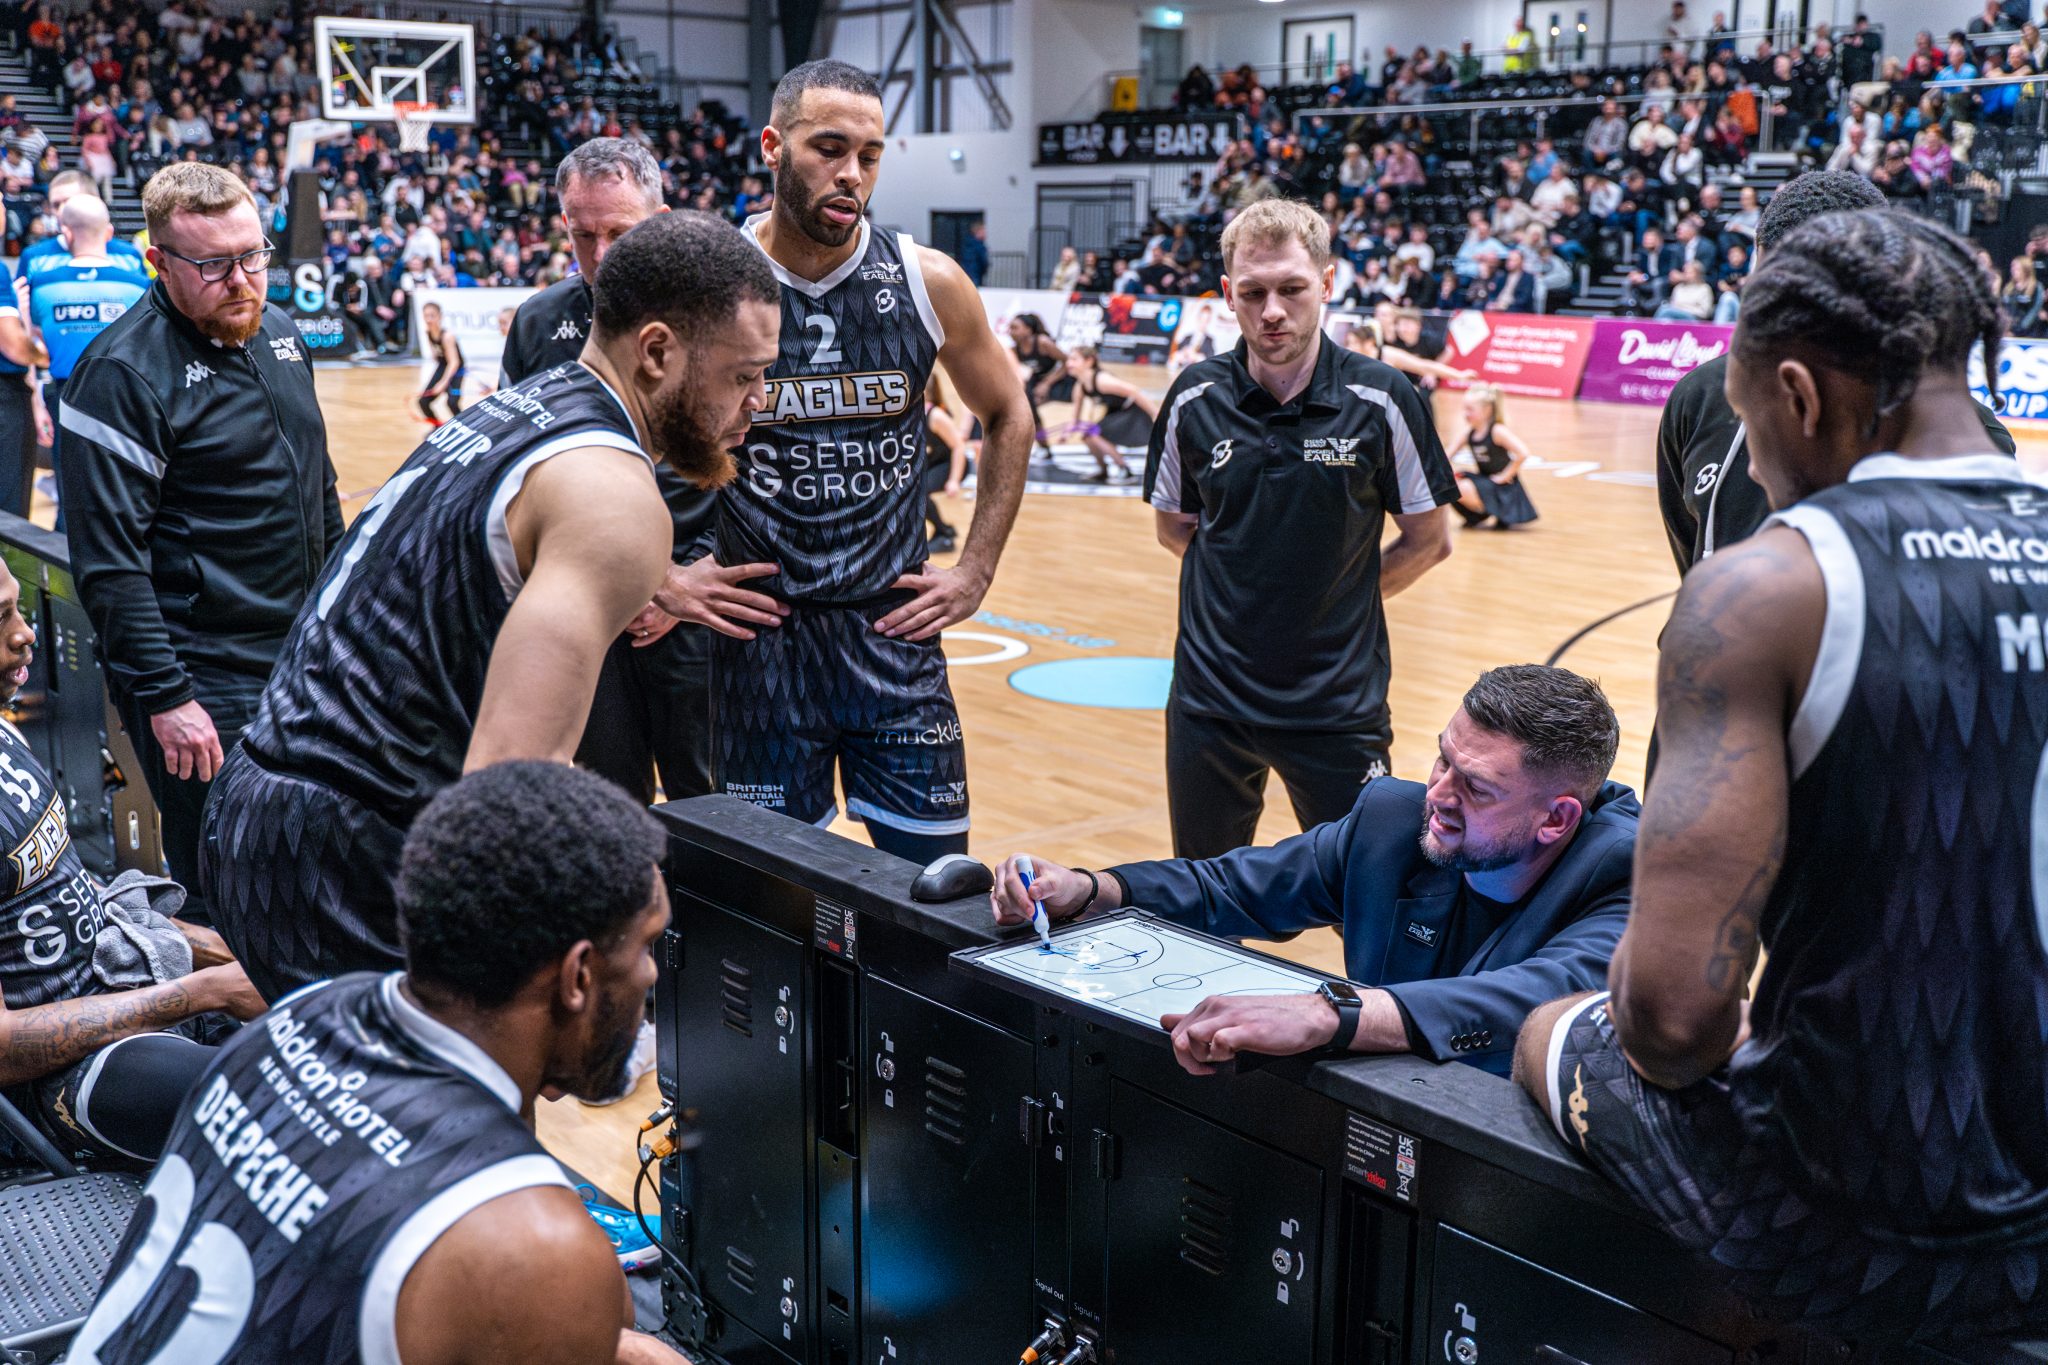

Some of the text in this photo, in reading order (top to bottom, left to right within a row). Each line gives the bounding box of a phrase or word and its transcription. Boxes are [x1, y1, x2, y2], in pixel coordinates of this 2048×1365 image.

[1063, 124, 1105, 150] BAR
[1154, 124, 1210, 155] BAR
[805, 314, 843, 364] 2
[1618, 329, 1725, 368] David Lloyd
[790, 431, 916, 471] SERIÖS
[1304, 452, 1357, 462] EAGLES
[792, 463, 911, 501] GROUP
[1995, 613, 2048, 673] M
[874, 720, 962, 745] muckle
[0, 751, 41, 814] 55
[727, 782, 784, 792] BRITISH
[727, 790, 785, 800] BASKETBALL
[931, 794, 965, 803] EAGLES
[258, 1055, 342, 1147] NEWCASTLE
[267, 1007, 412, 1168] maldron HOTEL
[1399, 1134, 1414, 1149] UK
[194, 1073, 330, 1244] DELPECHE
[1035, 1278, 1064, 1301] Signal out
[1074, 1302, 1093, 1318] Signal
